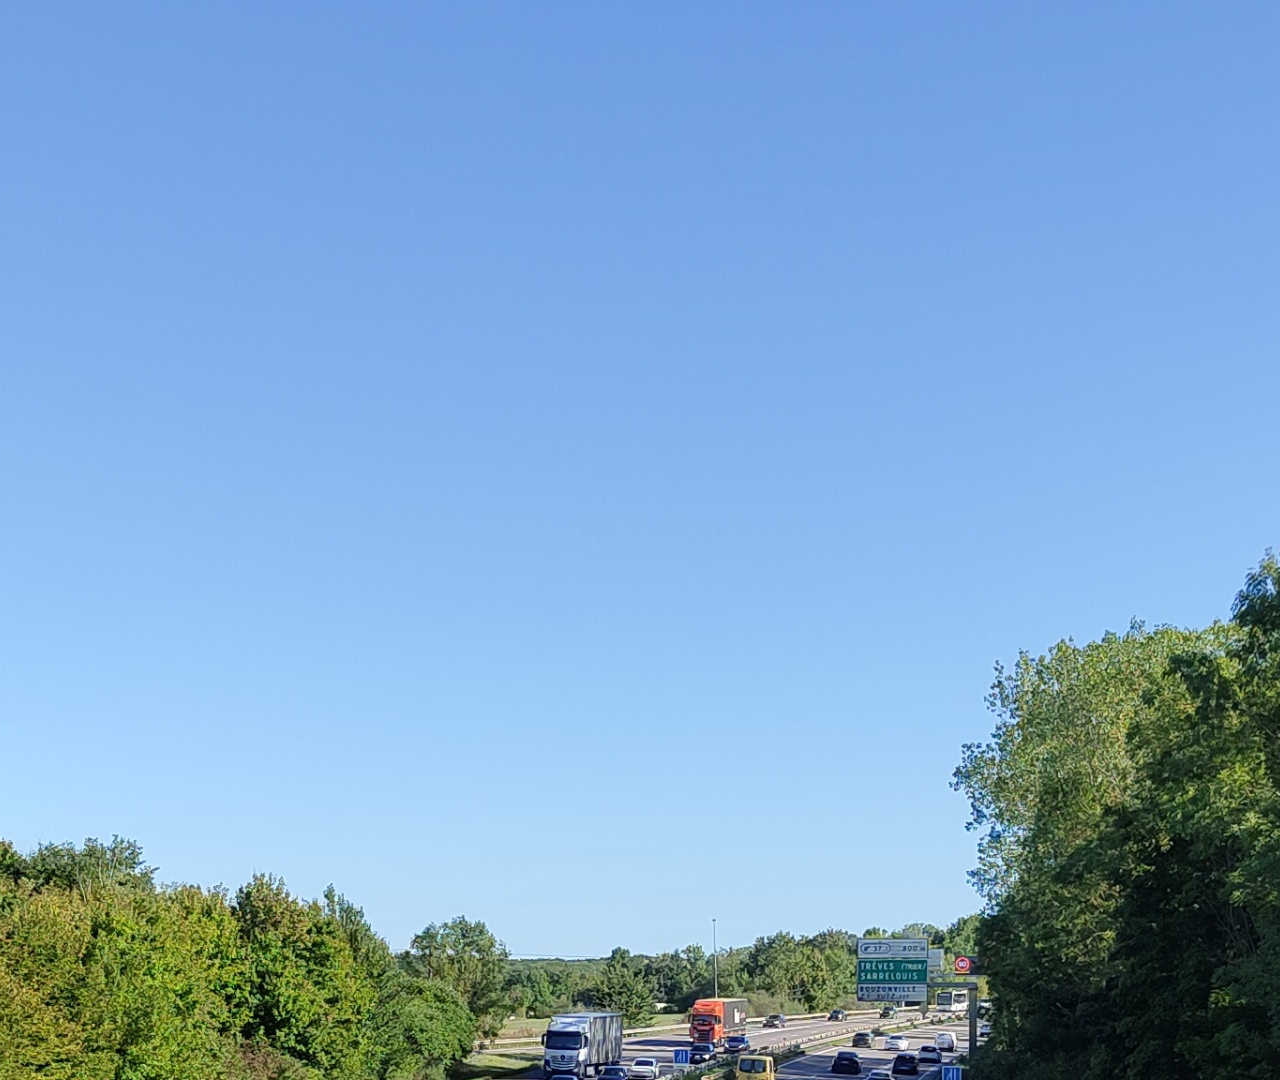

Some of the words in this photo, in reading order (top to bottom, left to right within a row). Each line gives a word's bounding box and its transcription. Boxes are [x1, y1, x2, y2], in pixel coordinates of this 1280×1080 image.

[860, 961, 894, 970] TRÈVES
[860, 972, 918, 980] SARRELOUIS
[860, 985, 917, 993] BOUZONVILLE
